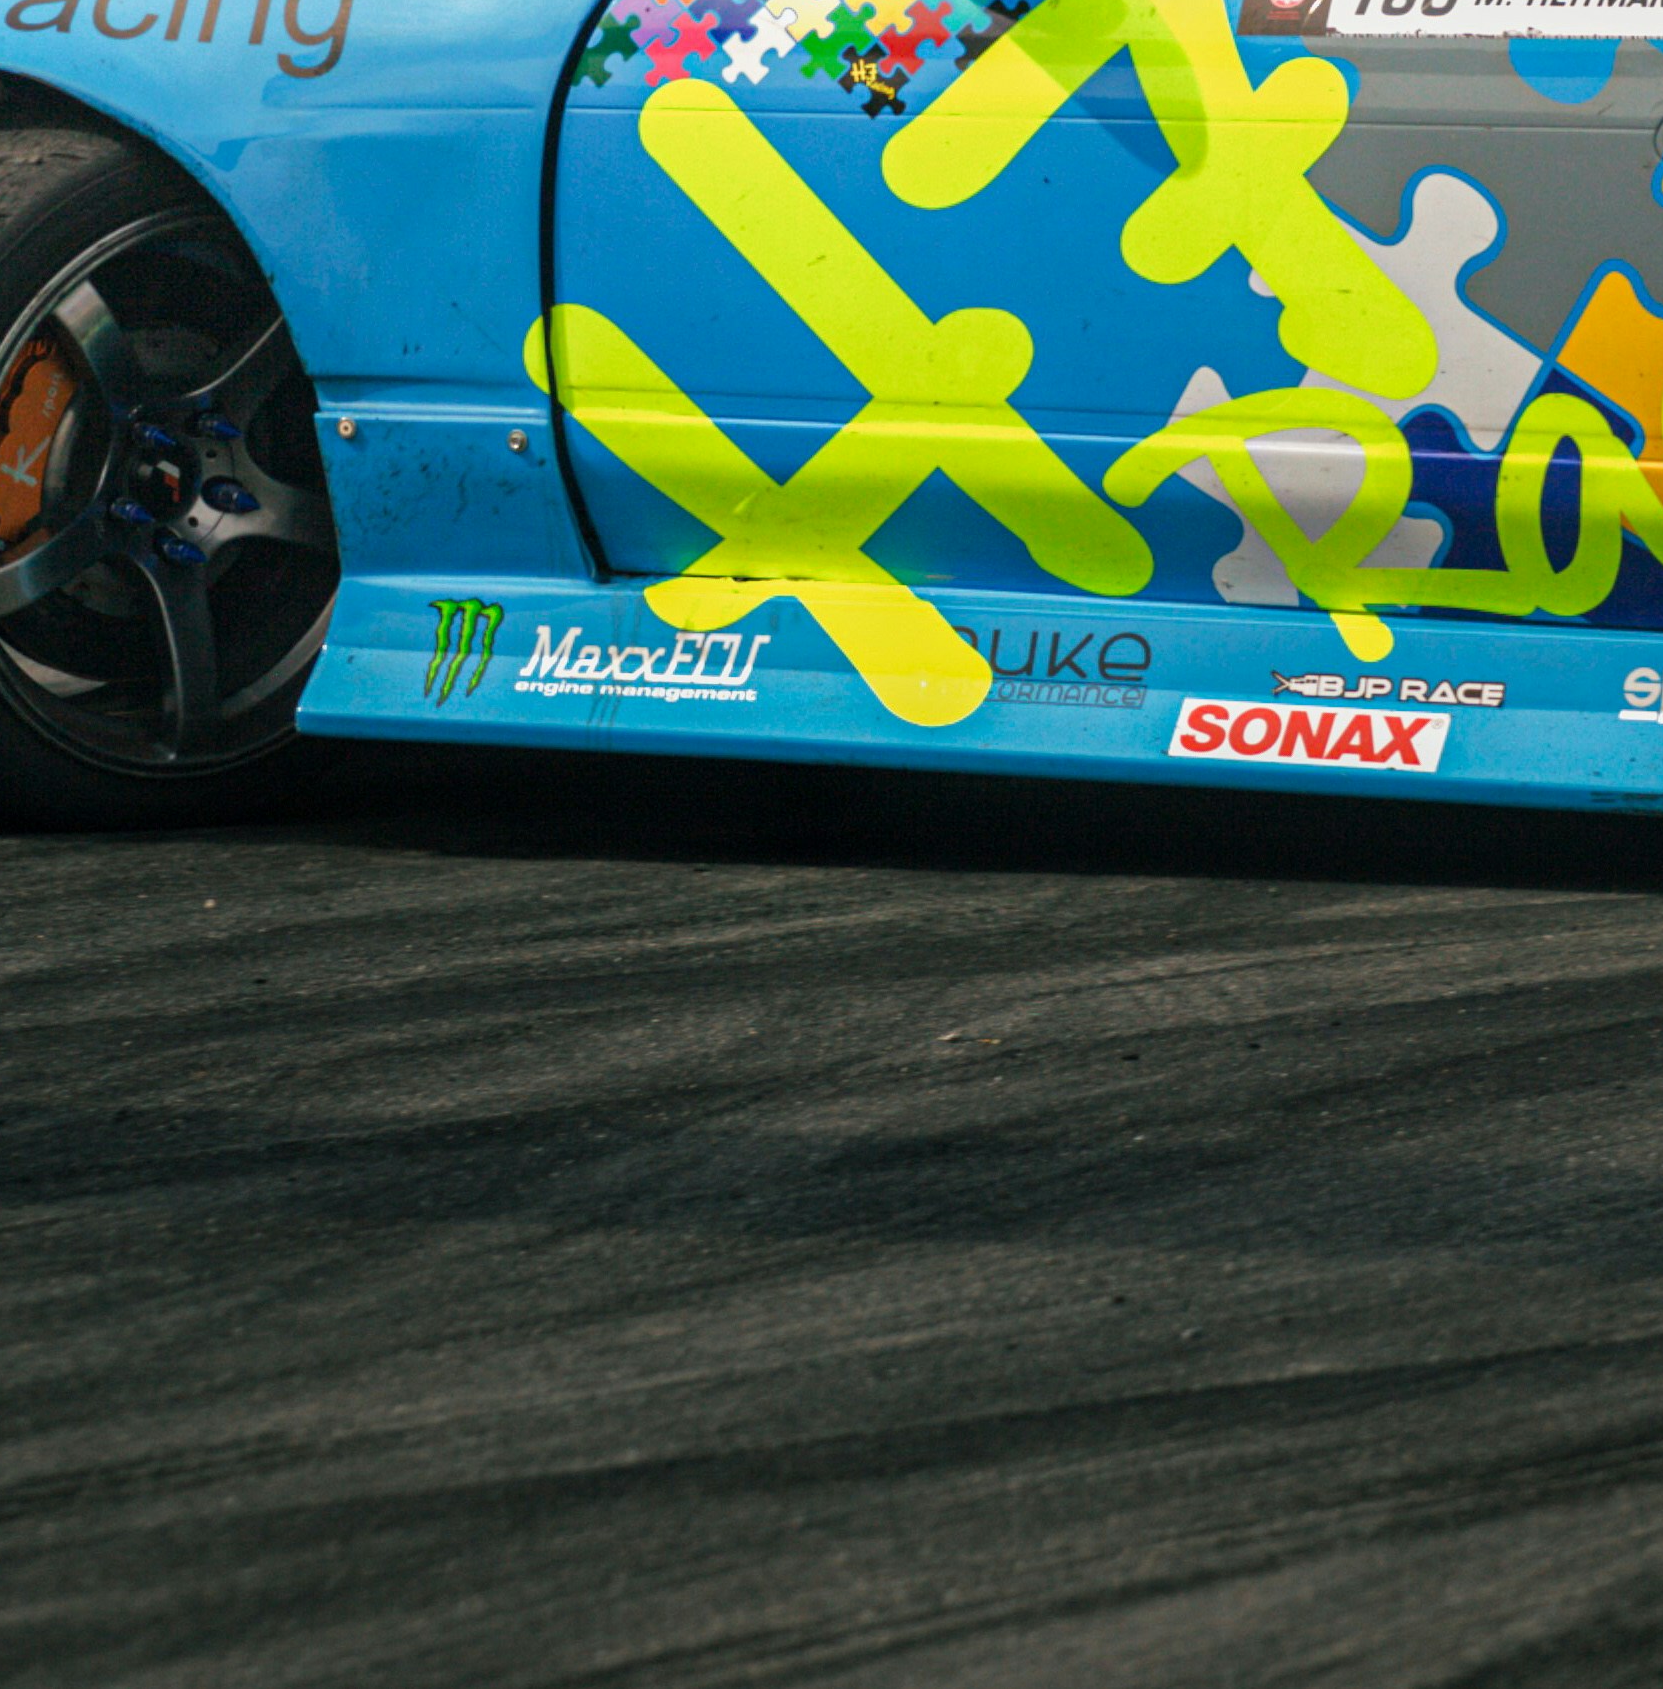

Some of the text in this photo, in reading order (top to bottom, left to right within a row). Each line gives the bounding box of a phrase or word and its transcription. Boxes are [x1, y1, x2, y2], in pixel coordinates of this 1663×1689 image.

[519, 625, 772, 686] MaxxECU
[514, 680, 758, 703] engine management
[1318, 675, 1506, 708] BJP RACE
[1179, 703, 1433, 766] SONAX
